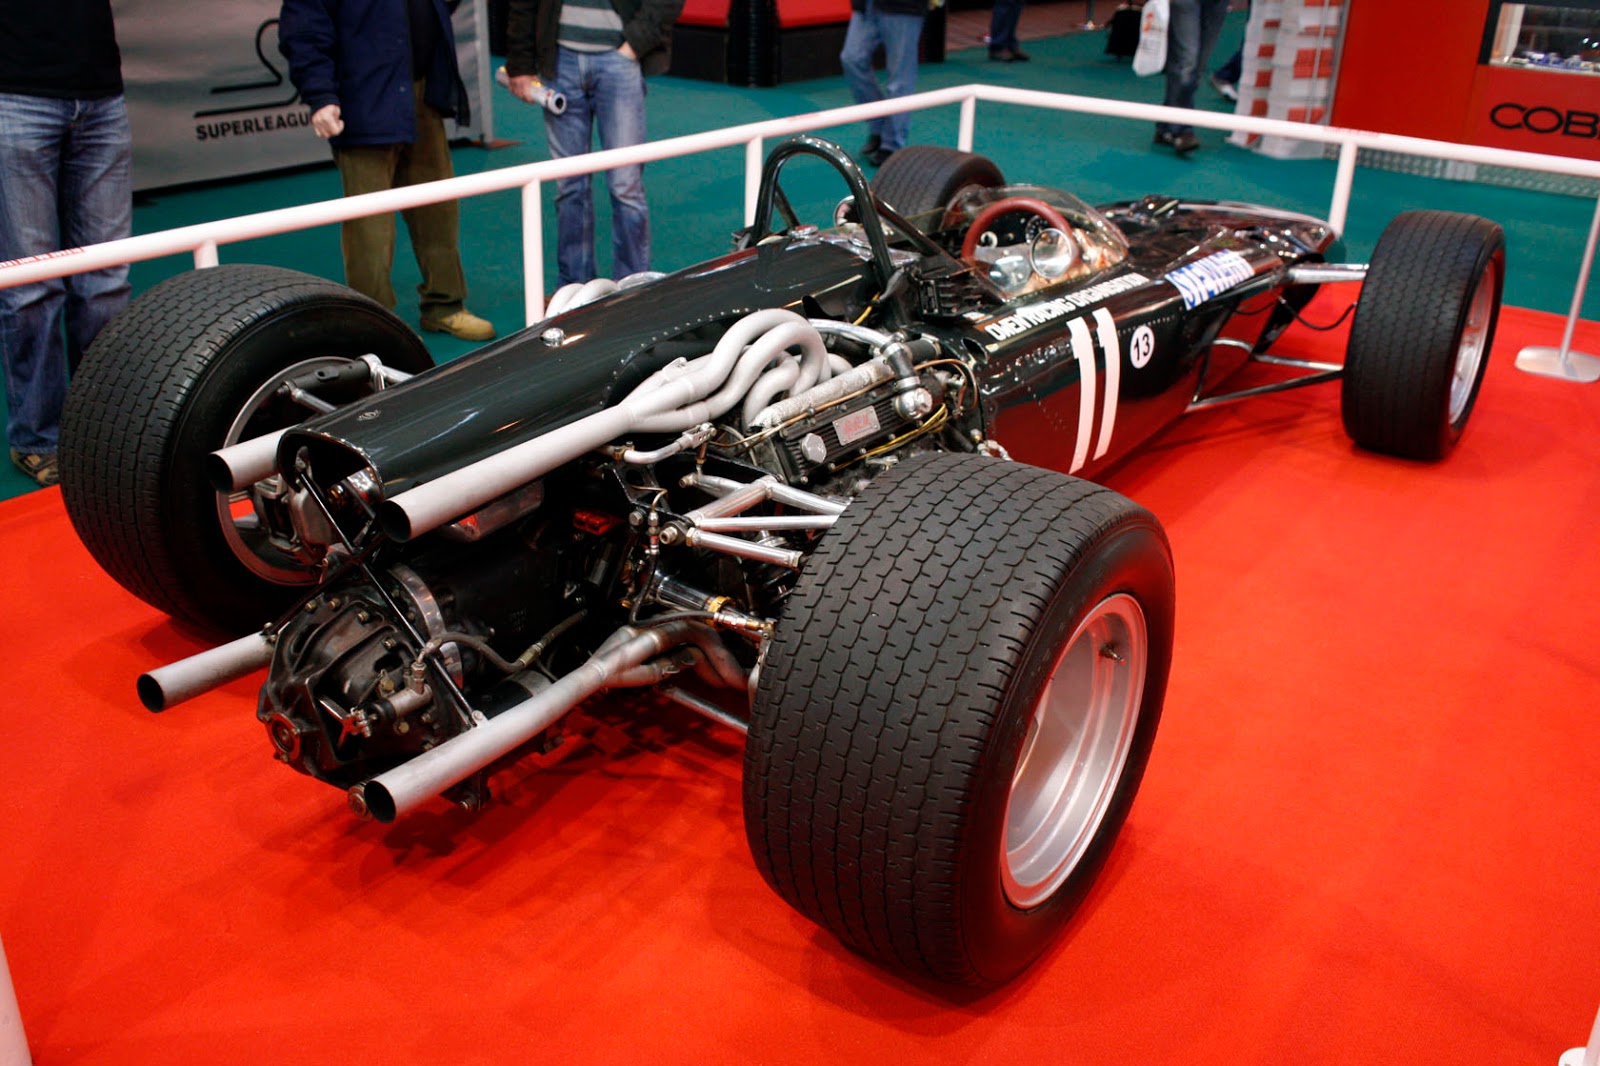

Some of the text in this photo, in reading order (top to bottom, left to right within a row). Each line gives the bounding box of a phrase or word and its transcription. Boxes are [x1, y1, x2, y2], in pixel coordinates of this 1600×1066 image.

[196, 112, 310, 140] SUPERLEAGU
[1490, 103, 1600, 140] COB
[985, 314, 1032, 341] OWEN
[1024, 298, 1076, 326] RACING
[1133, 332, 1151, 361] 13
[1066, 307, 1120, 475] 11
